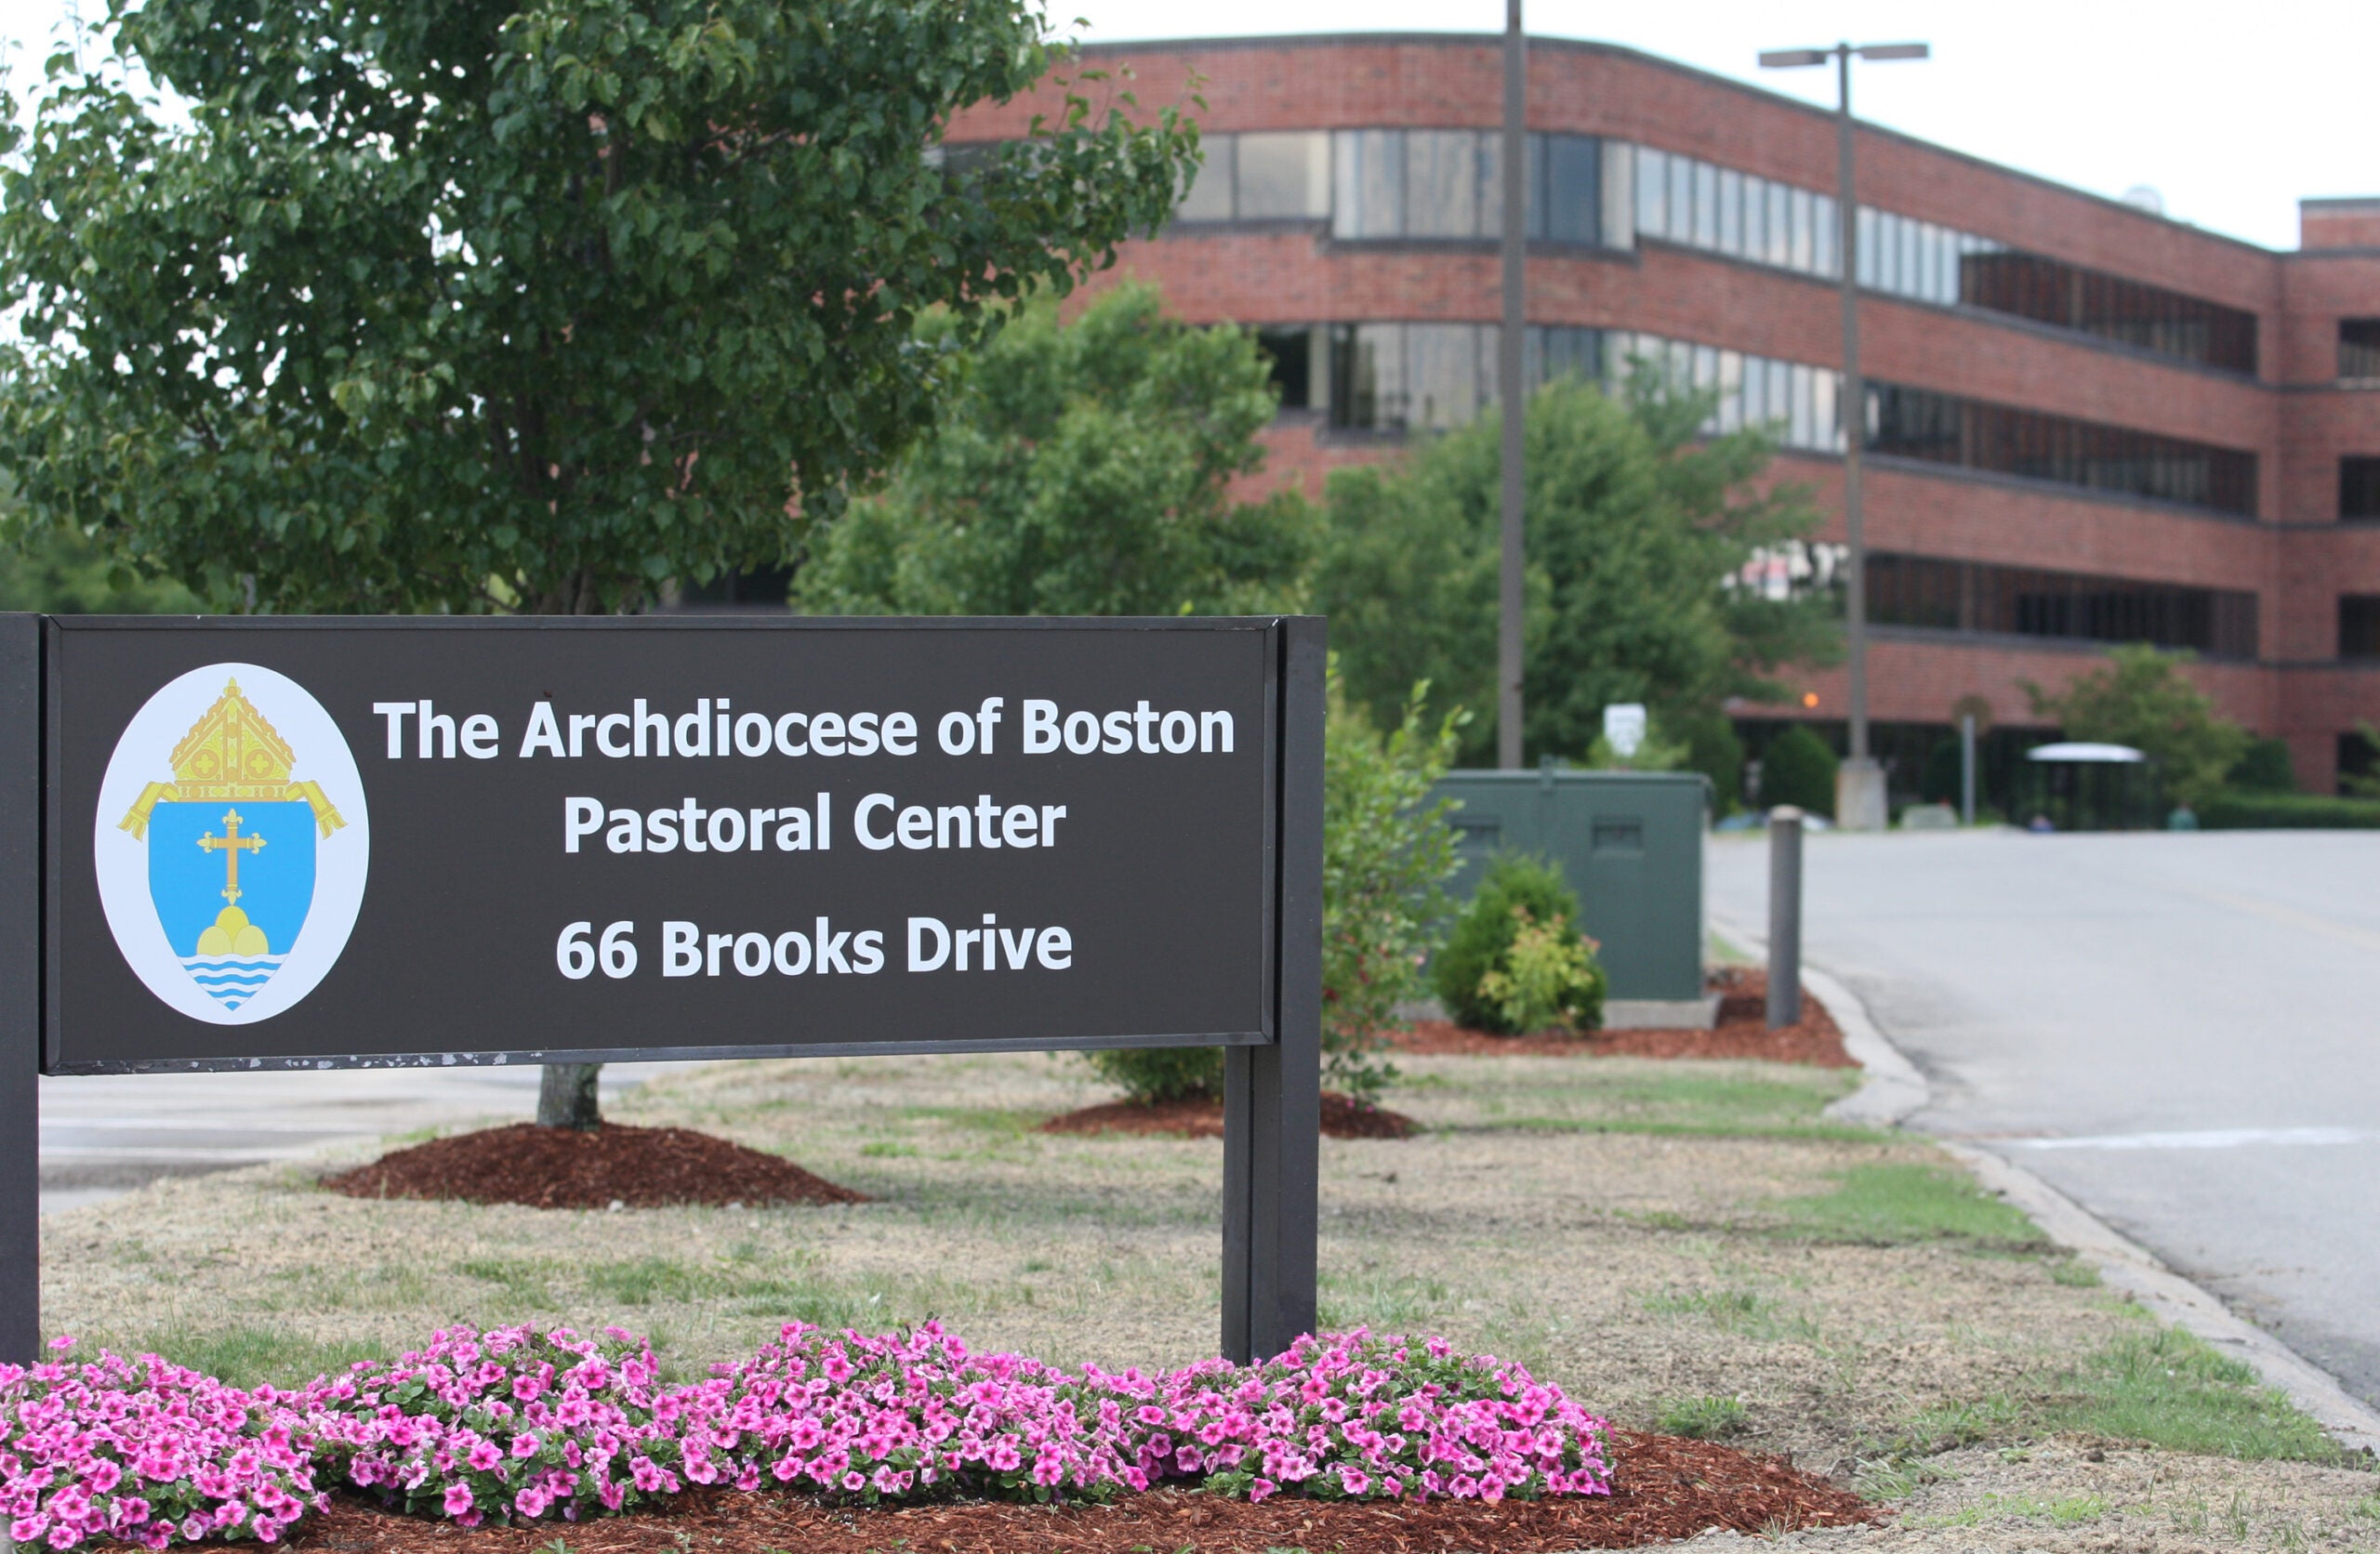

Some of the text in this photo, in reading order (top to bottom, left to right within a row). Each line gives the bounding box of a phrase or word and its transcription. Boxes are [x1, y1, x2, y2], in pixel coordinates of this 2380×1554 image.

[373, 696, 1236, 759] The Archdiocese of Boston
[564, 791, 1067, 854] Pastoral Center
[556, 913, 1073, 980] 66 Brooks Drive
